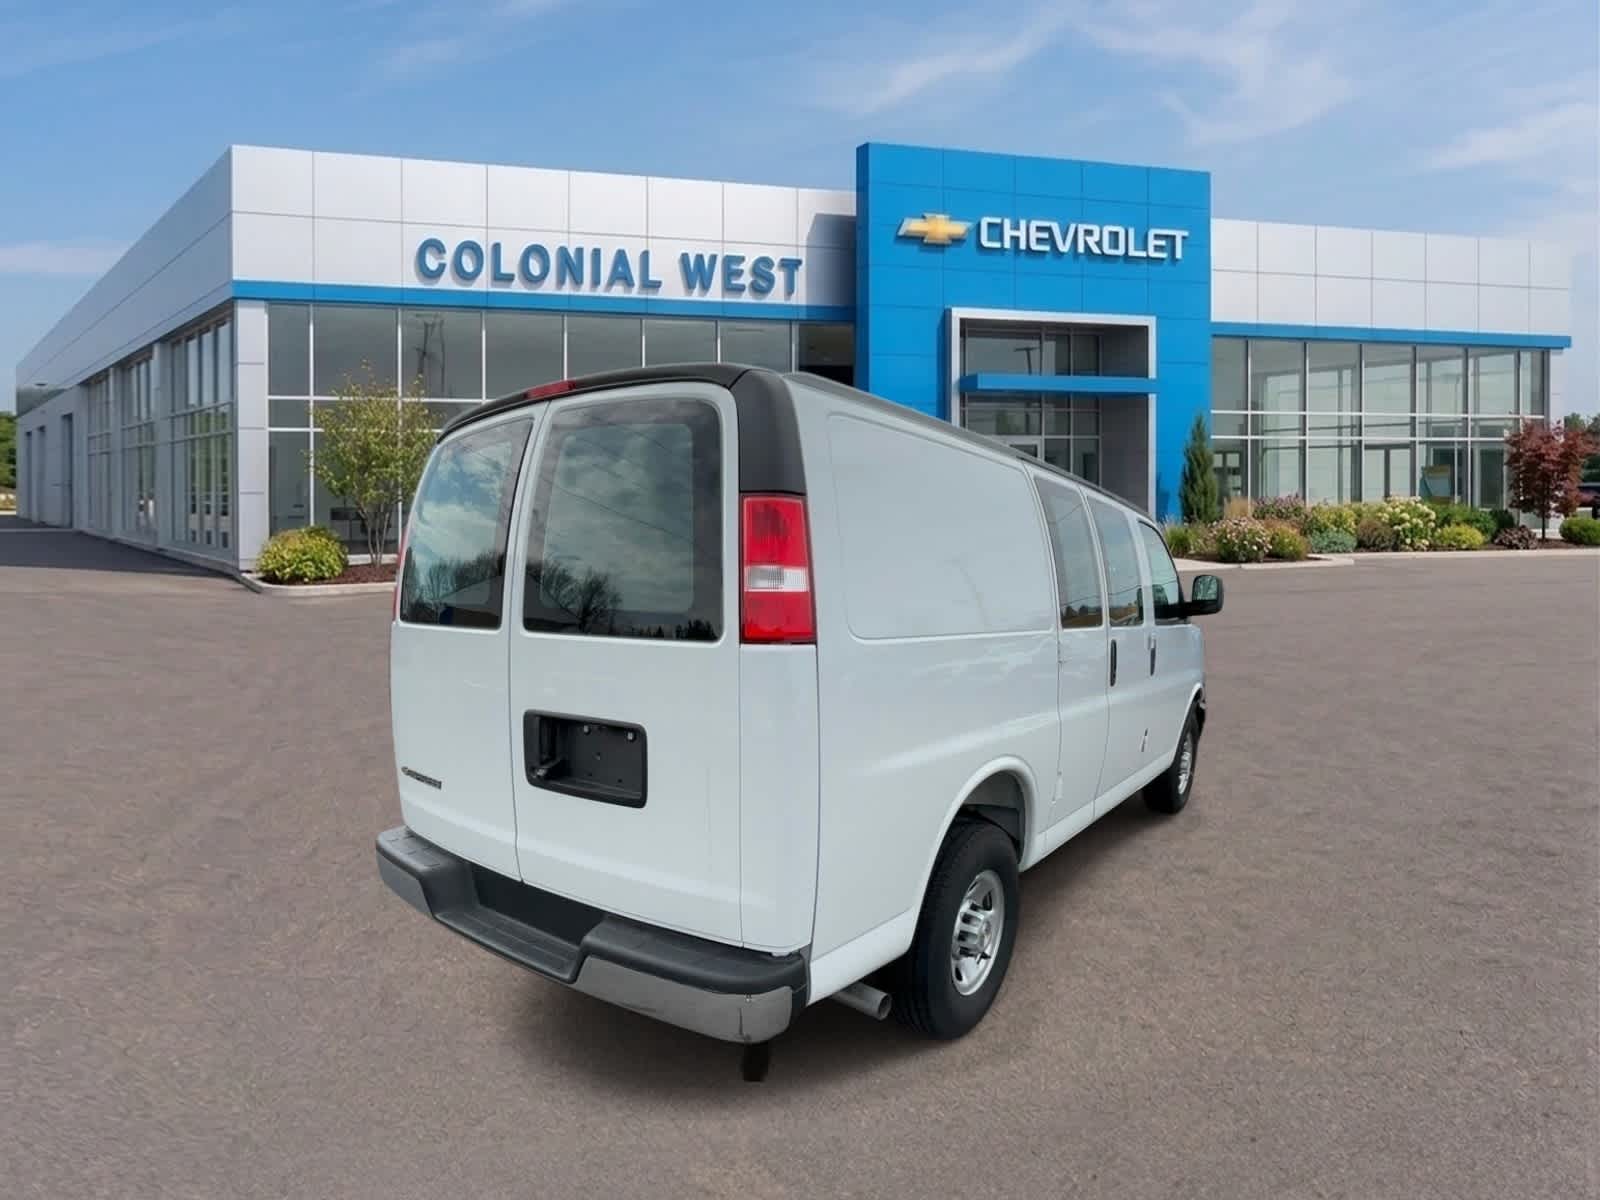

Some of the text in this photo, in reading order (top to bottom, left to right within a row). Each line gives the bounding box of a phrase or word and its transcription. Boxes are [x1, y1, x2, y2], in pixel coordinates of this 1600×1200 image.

[979, 216, 1189, 260] CHEVROLET
[415, 237, 803, 296] COLONIAL WEST
